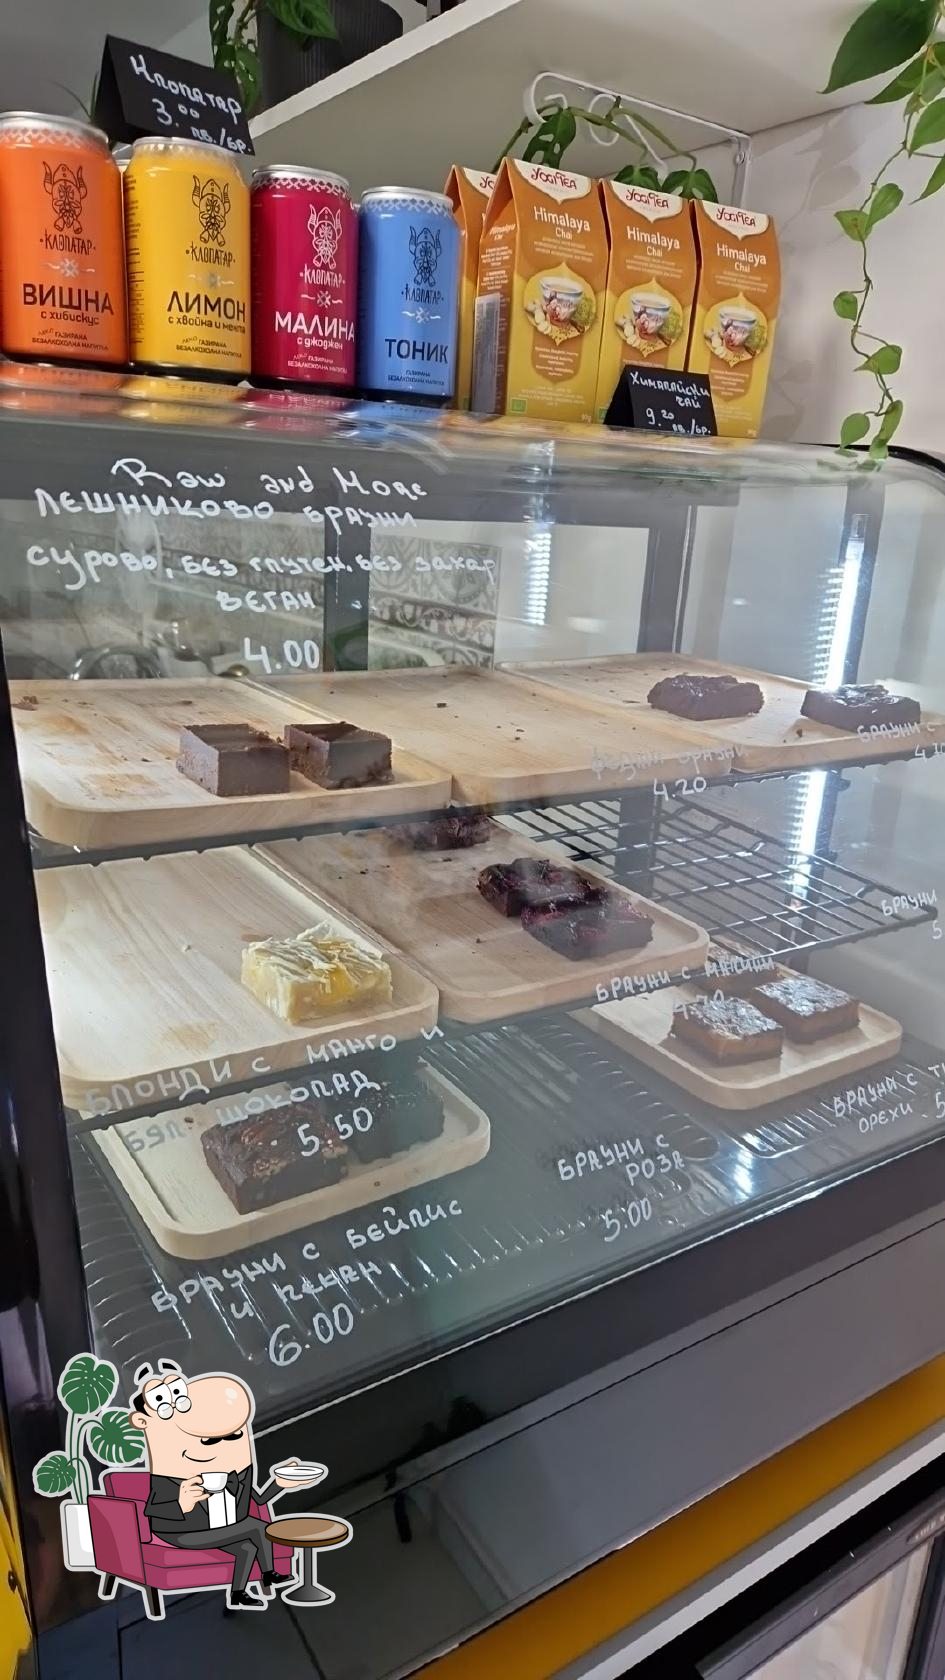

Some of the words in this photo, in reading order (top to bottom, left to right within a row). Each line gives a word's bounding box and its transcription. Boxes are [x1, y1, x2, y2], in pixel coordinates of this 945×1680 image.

[534, 206, 590, 234] Himalaya
[556, 227, 573, 240] Chai
[626, 226, 680, 251] Himalaya
[646, 246, 663, 257] Chai
[716, 243, 767, 267] Himalaya
[734, 262, 750, 272] Chai
[23, 283, 114, 315] ВИШНА
[167, 291, 245, 322] ЛИМОН
[41, 311, 47, 319] с
[50, 311, 99, 326] хибискус
[168, 316, 173, 324] с
[177, 315, 213, 328] хвойна
[223, 323, 245, 334] мента
[275, 311, 355, 342] МАЛИНА
[297, 337, 303, 345] с
[304, 336, 343, 350] джоджен
[385, 338, 448, 364] ТОНИК
[111, 458, 226, 488] Raw
[260, 466, 314, 494] and
[333, 467, 427, 500] More
[216, 590, 316, 612] ВЕГАН
[244, 637, 320, 674] 4.00
[653, 776, 708, 801] 4.20
[881, 889, 938, 916] БРАУНИ
[595, 970, 671, 1001] БРАУНИ
[306, 1035, 397, 1064] МАНГО
[833, 1076, 897, 1118] БРАУНИ
[859, 1103, 913, 1133] ОРЕХИ
[558, 1138, 645, 1181] БРАУНИ
[626, 1151, 685, 1187] РОЗА
[604, 1198, 652, 1242] 5.00
[151, 1253, 287, 1312] БРАУНИ
[269, 1303, 354, 1367] 6.00
